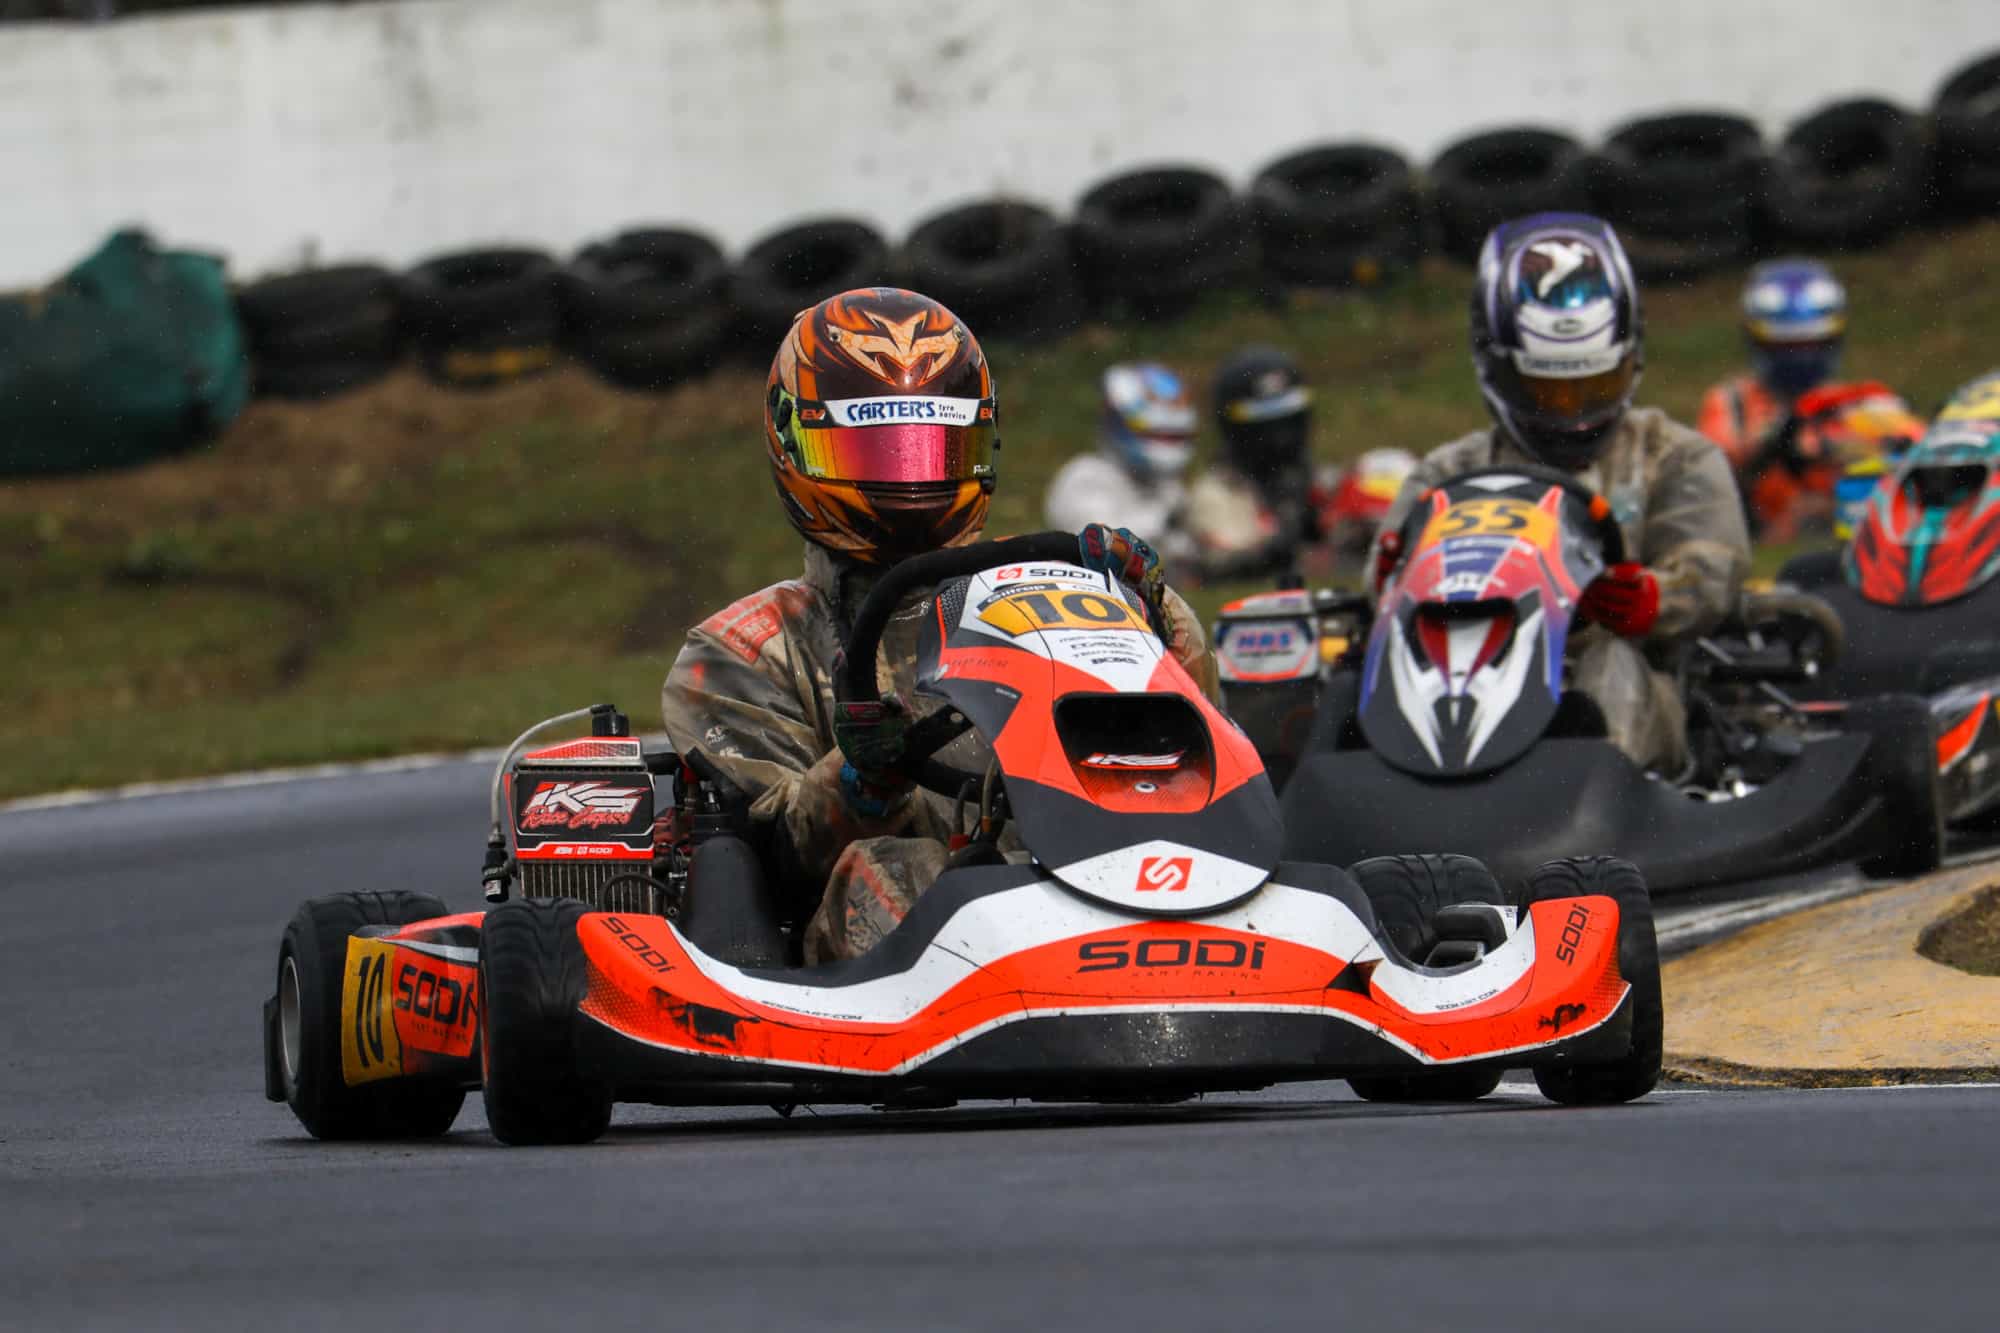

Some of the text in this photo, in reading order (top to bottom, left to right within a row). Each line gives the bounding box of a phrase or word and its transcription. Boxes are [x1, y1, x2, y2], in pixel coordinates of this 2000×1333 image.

[847, 401, 936, 422] CARTER'S
[939, 412, 967, 420] service
[1440, 503, 1527, 536] 55
[1011, 593, 1127, 625] 10
[356, 953, 385, 1069] 10
